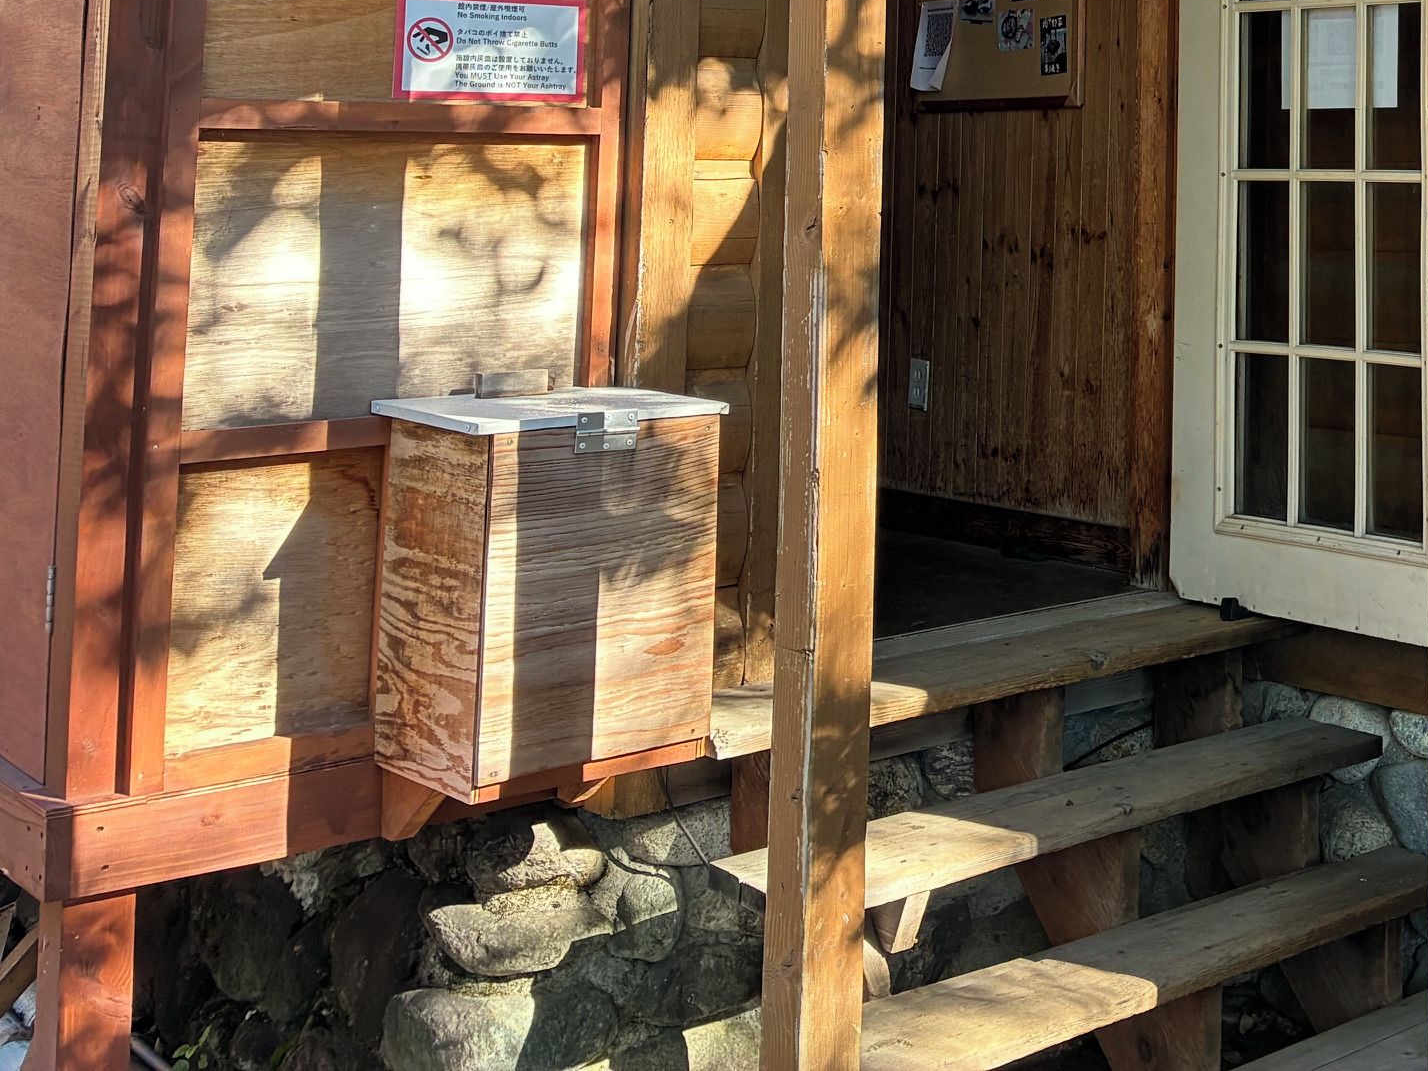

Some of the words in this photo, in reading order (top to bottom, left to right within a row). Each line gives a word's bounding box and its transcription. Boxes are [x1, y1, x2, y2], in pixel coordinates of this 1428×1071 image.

[469, 12, 500, 21] Smoking
[501, 14, 527, 22] Indoors
[468, 37, 481, 45] Not
[483, 38, 505, 46] Throw
[506, 39, 539, 47] Cigarette
[540, 40, 558, 48] Butts
[455, 71, 468, 79] You
[470, 72, 492, 80] MUST
[509, 73, 526, 81] Your
[527, 74, 550, 83] Astray
[469, 81, 496, 89] Ground
[540, 83, 566, 91] Ashtray
